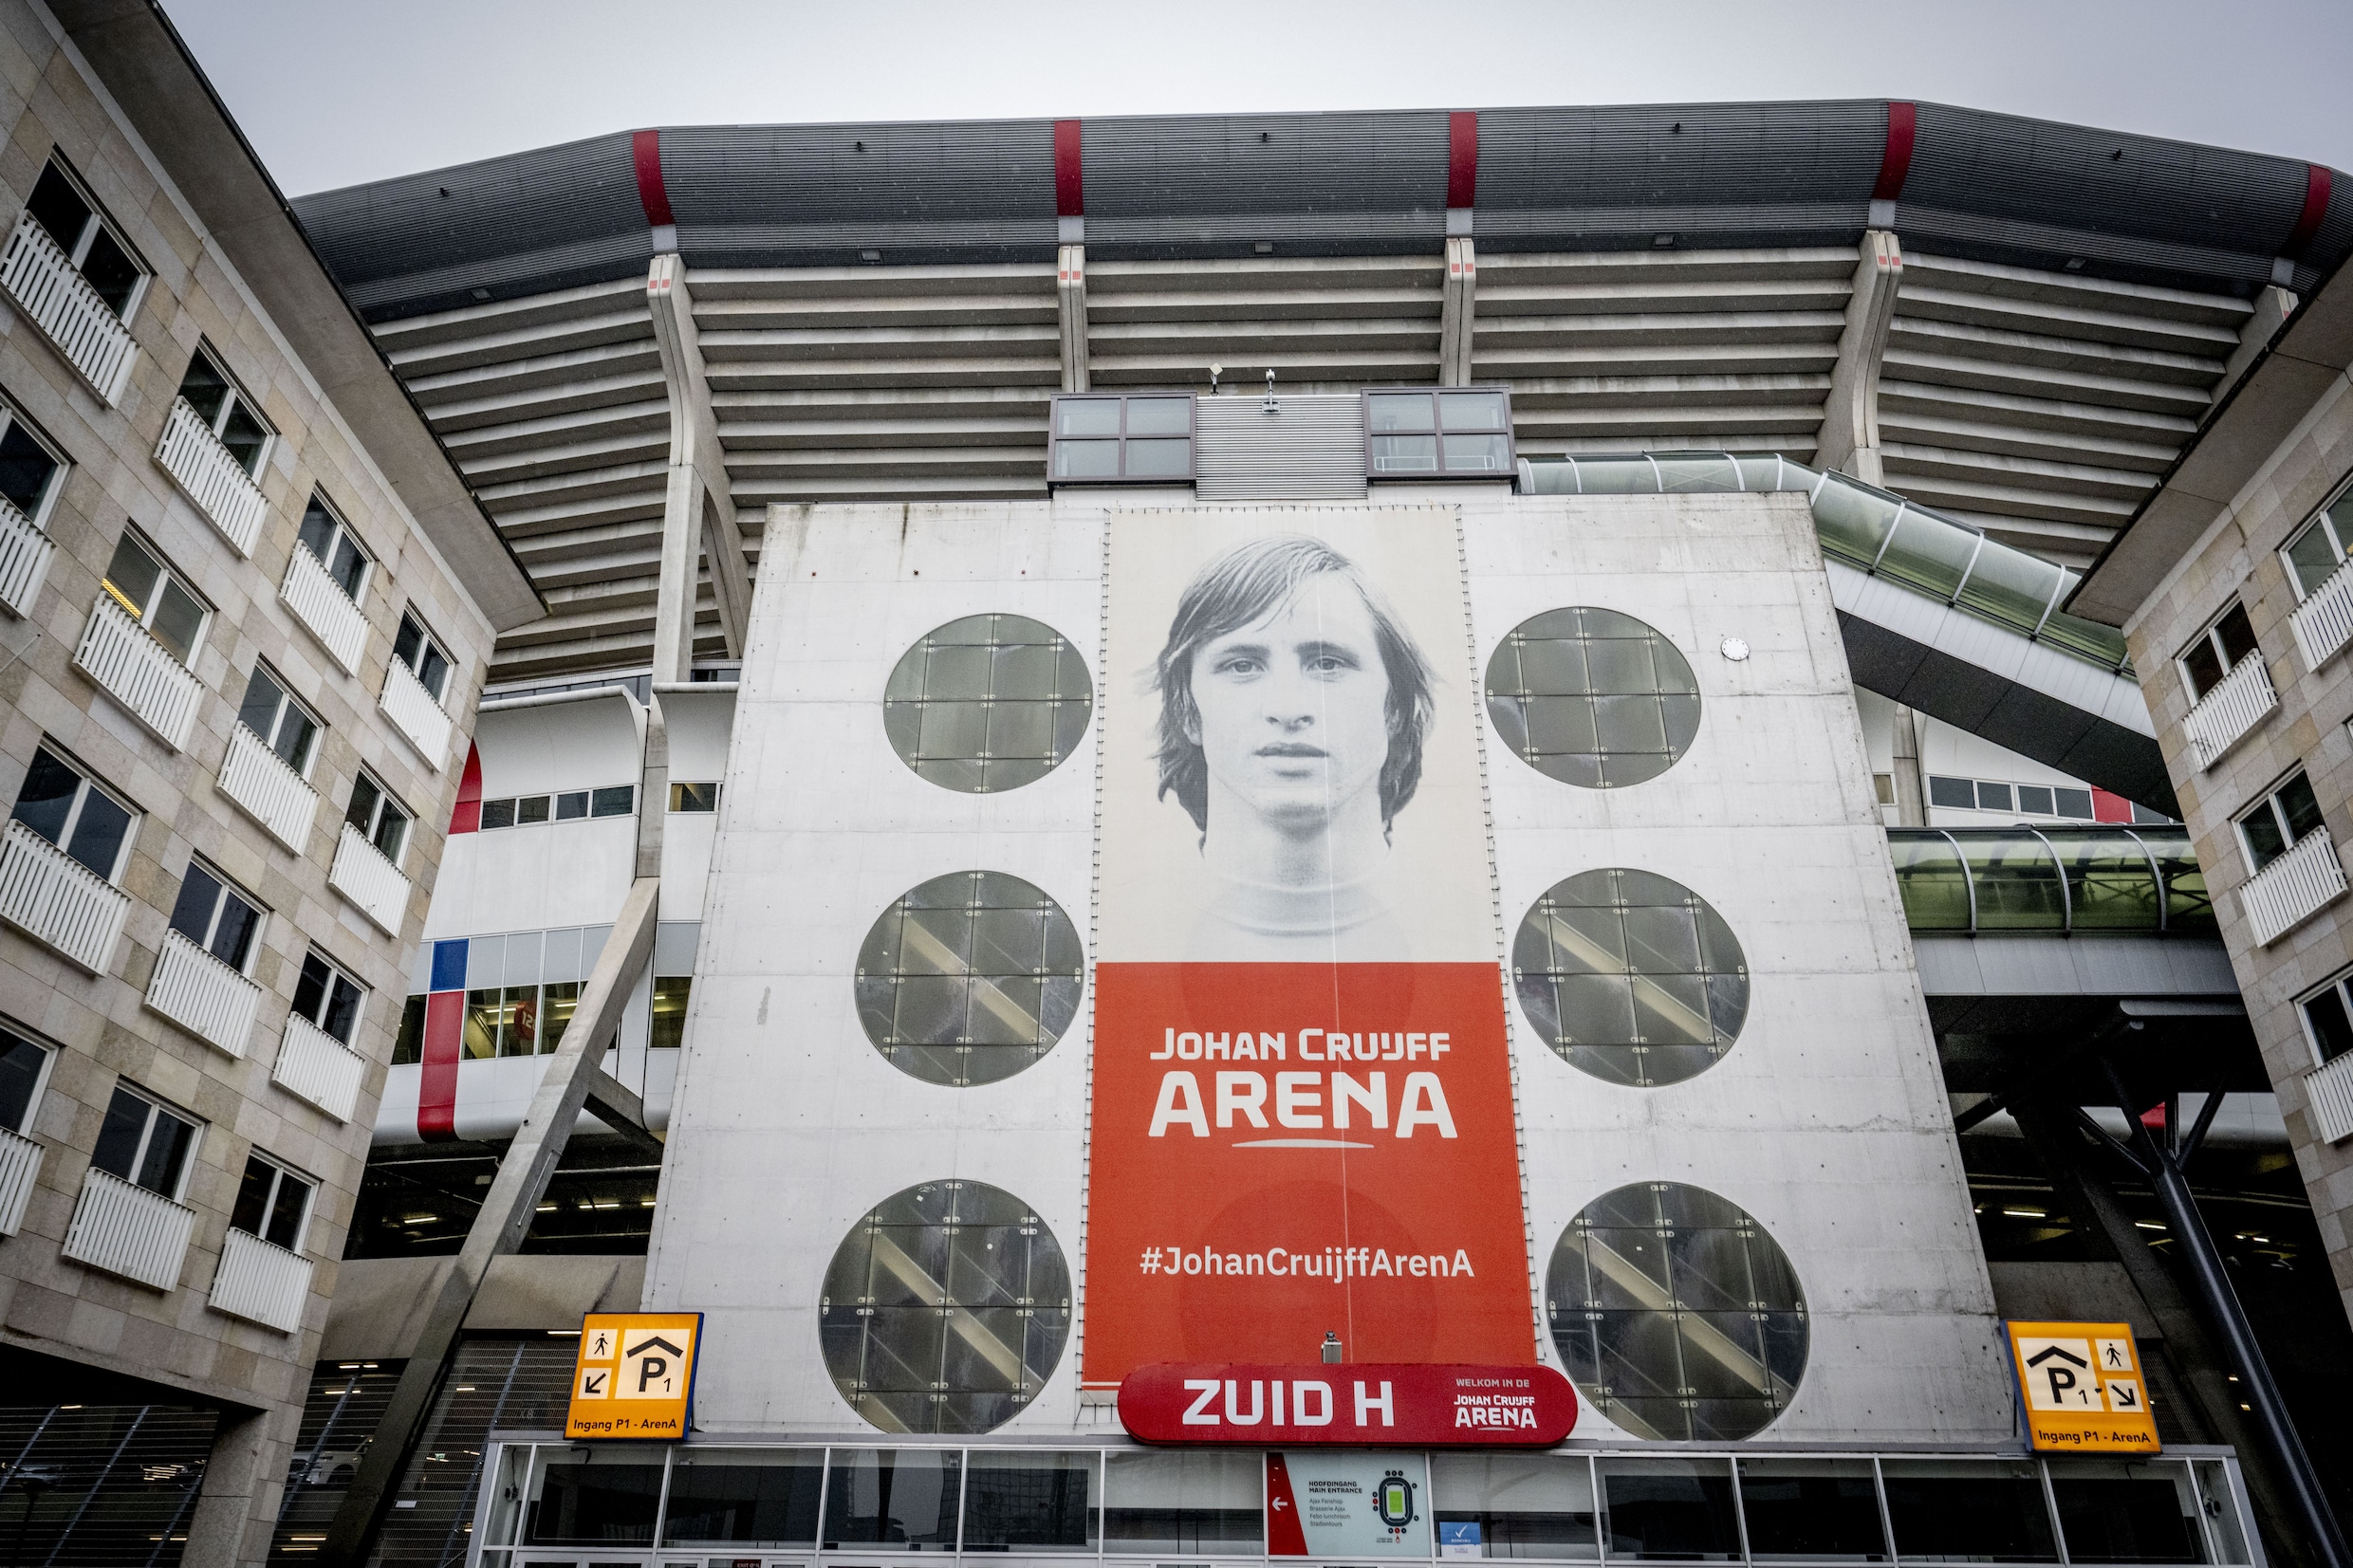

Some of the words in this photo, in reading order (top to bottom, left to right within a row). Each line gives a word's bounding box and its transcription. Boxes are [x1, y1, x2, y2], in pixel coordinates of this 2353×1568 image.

[1150, 1028, 1286, 1061] JOHAN
[1148, 1071, 1458, 1138] ARENA
[1139, 1245, 1474, 1283] #JohanCruijffArenA
[1455, 1378, 1500, 1388] WELKOM
[1502, 1378, 1513, 1388] IN
[1515, 1378, 1530, 1388] DE
[1182, 1379, 1334, 1427] ZUID
[1354, 1381, 1395, 1427] H
[1454, 1394, 1491, 1406] JOHAN
[573, 1419, 612, 1432] Ingang
[616, 1419, 630, 1430] P1
[640, 1419, 677, 1430] ArenA
[1454, 1407, 1538, 1429] ARENA
[2038, 1430, 2082, 1445] Ingang
[2084, 1430, 2100, 1442] P1
[2111, 1431, 2152, 1443] ArenA
